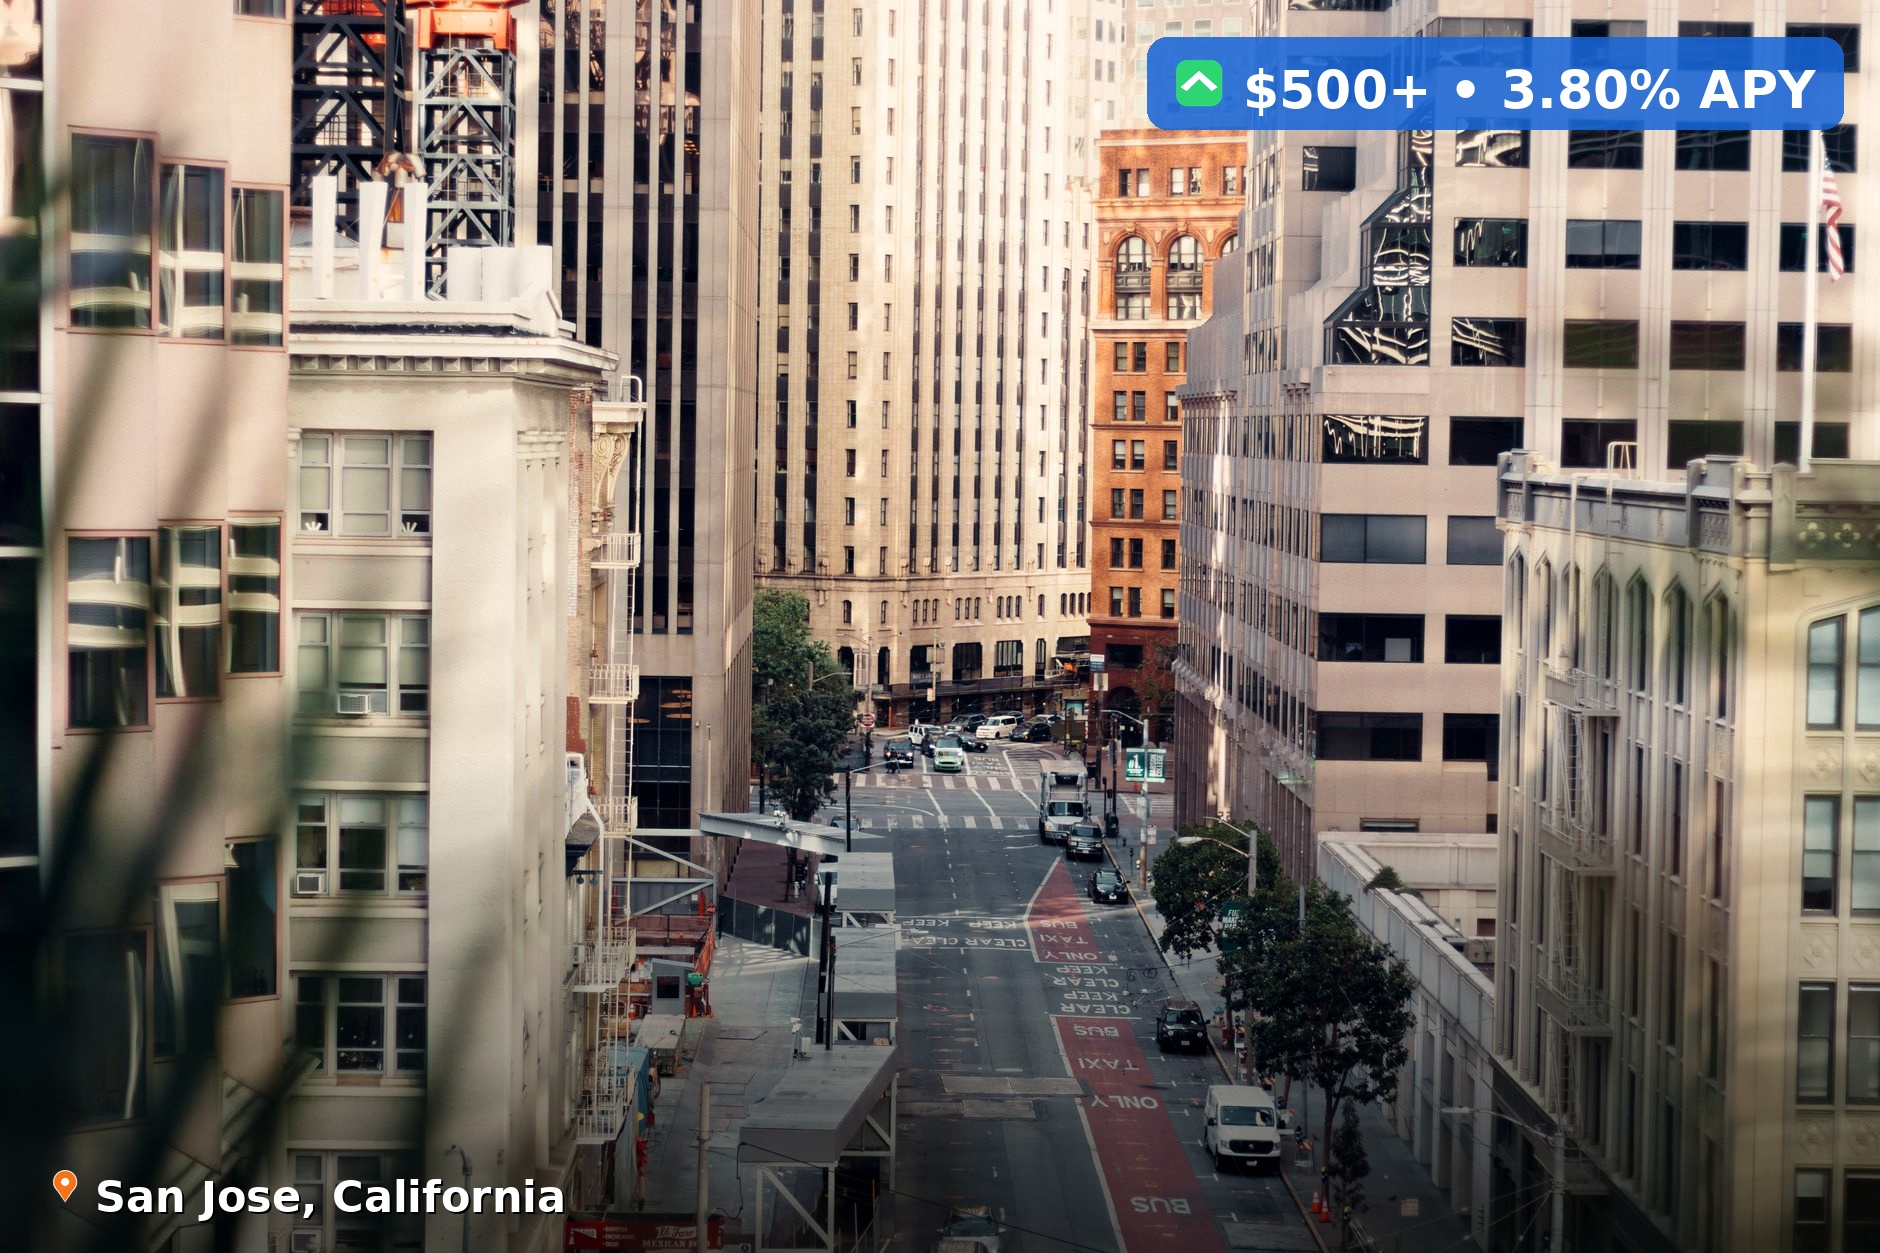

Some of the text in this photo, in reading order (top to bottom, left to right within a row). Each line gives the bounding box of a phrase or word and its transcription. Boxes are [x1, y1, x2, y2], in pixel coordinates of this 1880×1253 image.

[901, 918, 949, 927] KEEP
[969, 919, 1017, 929] KEEP
[1040, 919, 1078, 929] BUS
[965, 937, 1027, 947] CLEAR
[1039, 934, 1089, 944] TAXI
[1043, 951, 1098, 961] ONLY
[1056, 964, 1108, 975] KEEP
[1053, 976, 1120, 988] CLEAR
[1063, 990, 1118, 1001] KEEP
[1060, 1002, 1131, 1015] CLEAR
[1074, 1025, 1120, 1038] BUS
[1078, 1057, 1140, 1071] TAXI
[1091, 1095, 1159, 1110] ONLY
[1130, 1197, 1192, 1215] BUS
[642, 1239, 686, 1248] MEXICAN
